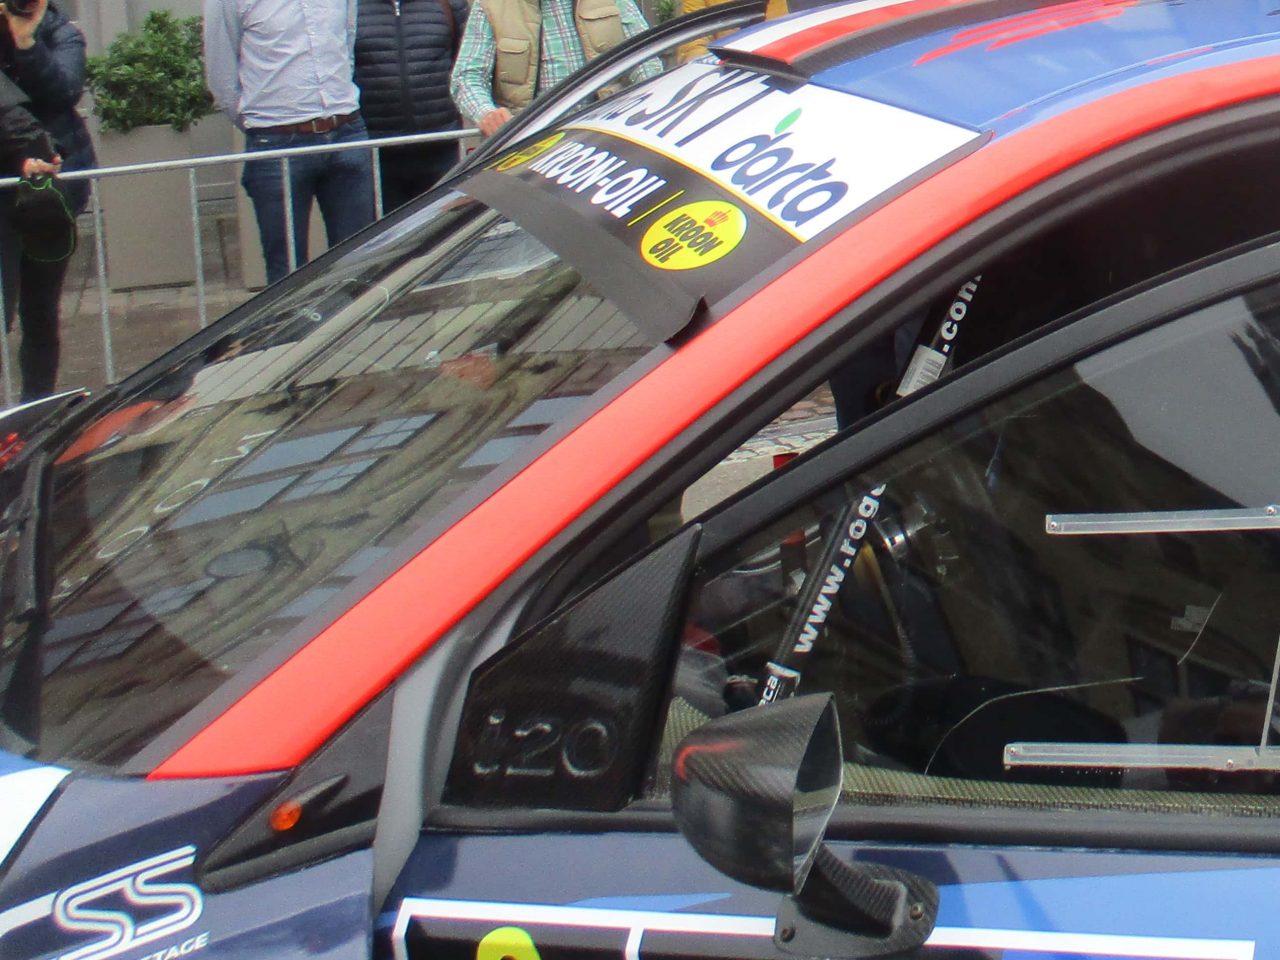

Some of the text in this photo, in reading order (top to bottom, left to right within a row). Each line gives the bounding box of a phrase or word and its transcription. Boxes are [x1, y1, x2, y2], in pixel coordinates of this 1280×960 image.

[528, 141, 668, 219] KROON-OIL
[648, 236, 684, 264] OIL
[662, 212, 725, 257] KROON
[473, 711, 619, 778] i20
[140, 930, 211, 960] TAGE
